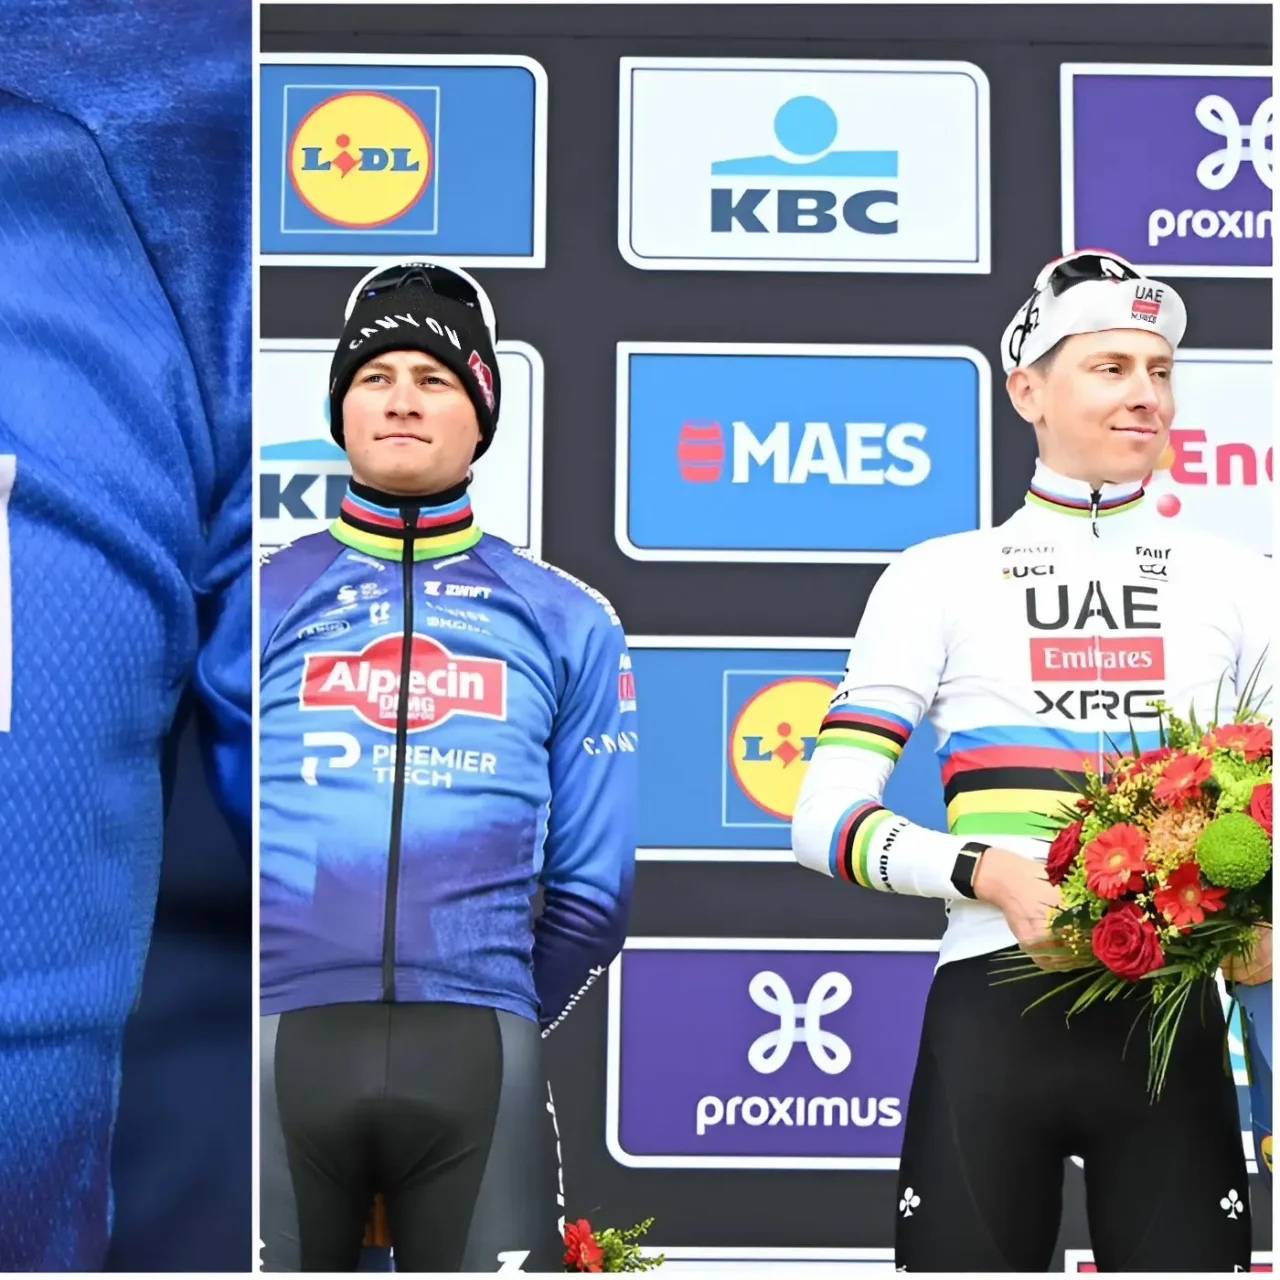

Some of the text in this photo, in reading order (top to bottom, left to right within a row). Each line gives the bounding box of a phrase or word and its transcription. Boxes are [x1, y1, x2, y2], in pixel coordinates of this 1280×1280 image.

[709, 187, 899, 235] KBC
[1135, 285, 1164, 303] UAE
[348, 313, 462, 351] CANYON
[731, 421, 932, 487] MAES
[1168, 429, 1273, 486] En
[1025, 579, 1162, 631] UAE
[1043, 645, 1153, 669] Emirates
[318, 661, 484, 703] Alpecin
[372, 743, 497, 775] PREMIER
[372, 766, 453, 789] TECH
[696, 1095, 902, 1136] proximus
